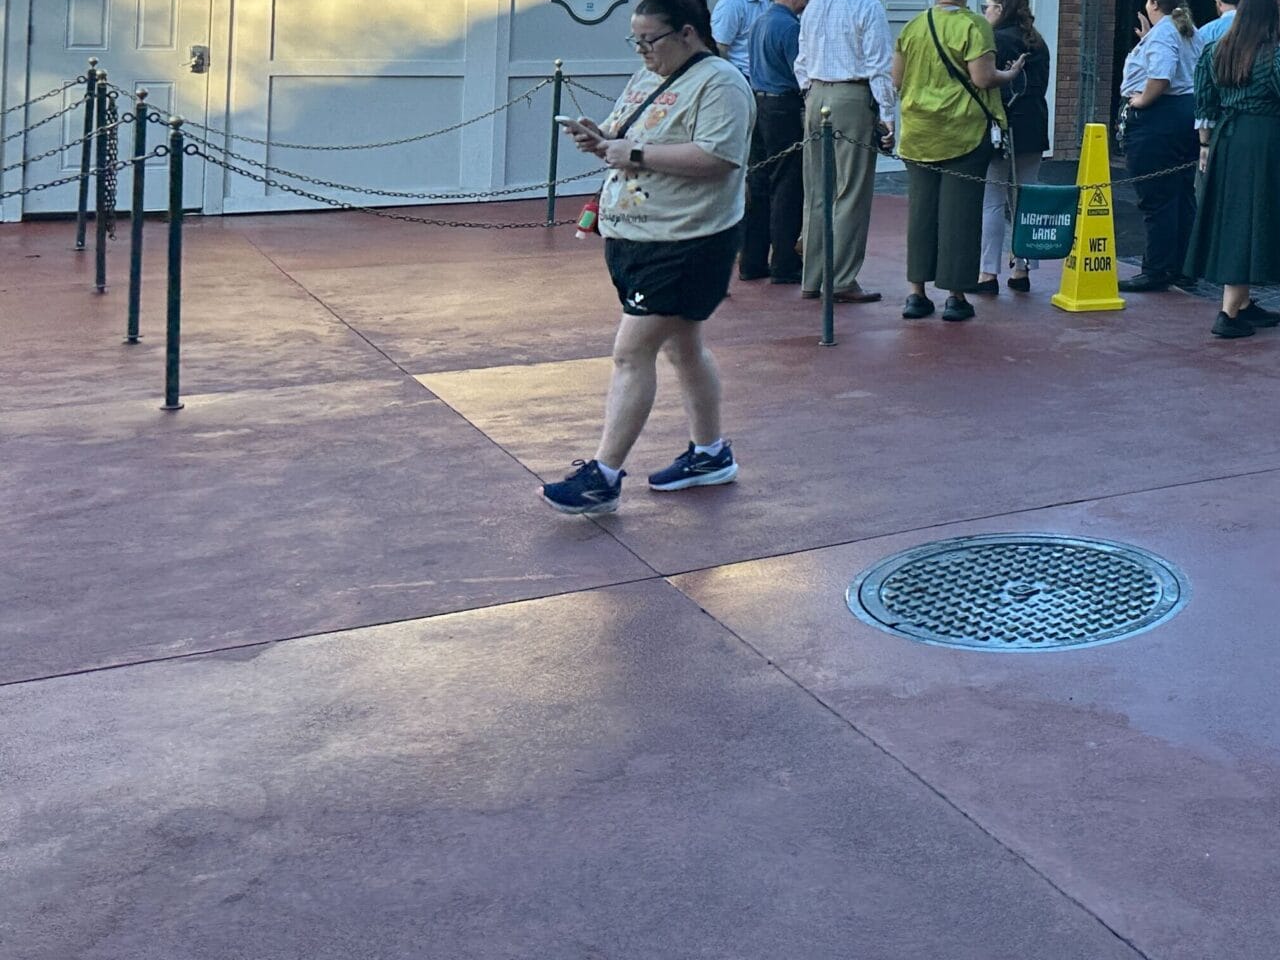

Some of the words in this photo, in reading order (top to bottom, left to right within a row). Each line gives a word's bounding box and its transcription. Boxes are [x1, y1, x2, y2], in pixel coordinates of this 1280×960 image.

[1021, 213, 1071, 226] LIGHTNING
[1032, 228, 1057, 240] LANE
[1089, 237, 1107, 252] WET
[1084, 256, 1112, 272] FLOOR
